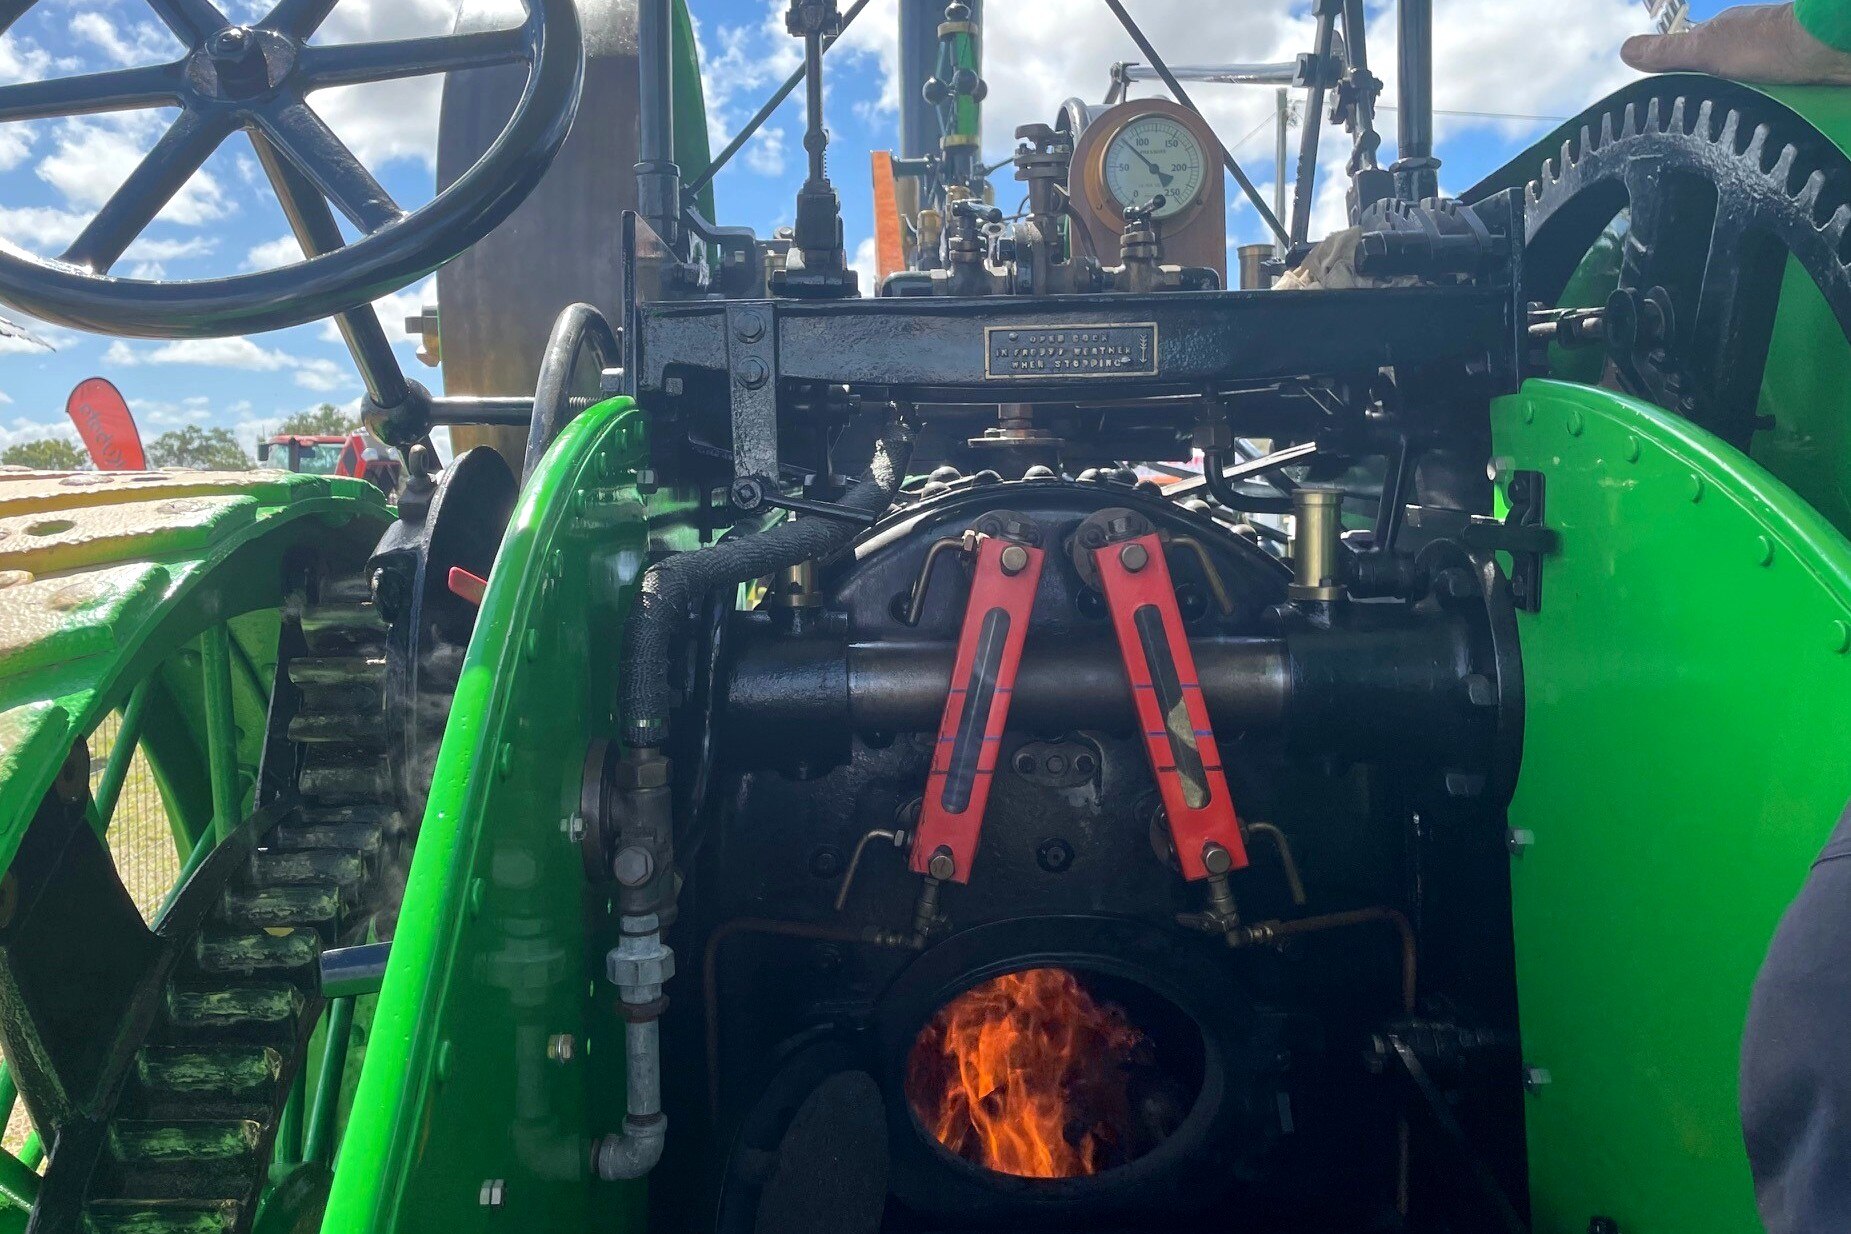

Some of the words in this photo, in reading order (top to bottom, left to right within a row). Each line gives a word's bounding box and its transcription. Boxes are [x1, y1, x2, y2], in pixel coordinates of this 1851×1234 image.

[1136, 138, 1149, 146] 100
[1165, 140, 1179, 148] 150
[1120, 163, 1130, 172] 50
[1171, 163, 1187, 172] 200
[1165, 188, 1180, 197] 250
[1029, 334, 1065, 343] OPEN
[996, 348, 1008, 357] IN
[1074, 346, 1131, 356] WEATHER
[1011, 361, 1044, 369] WHEN
[1055, 359, 1121, 368] STOPPING
